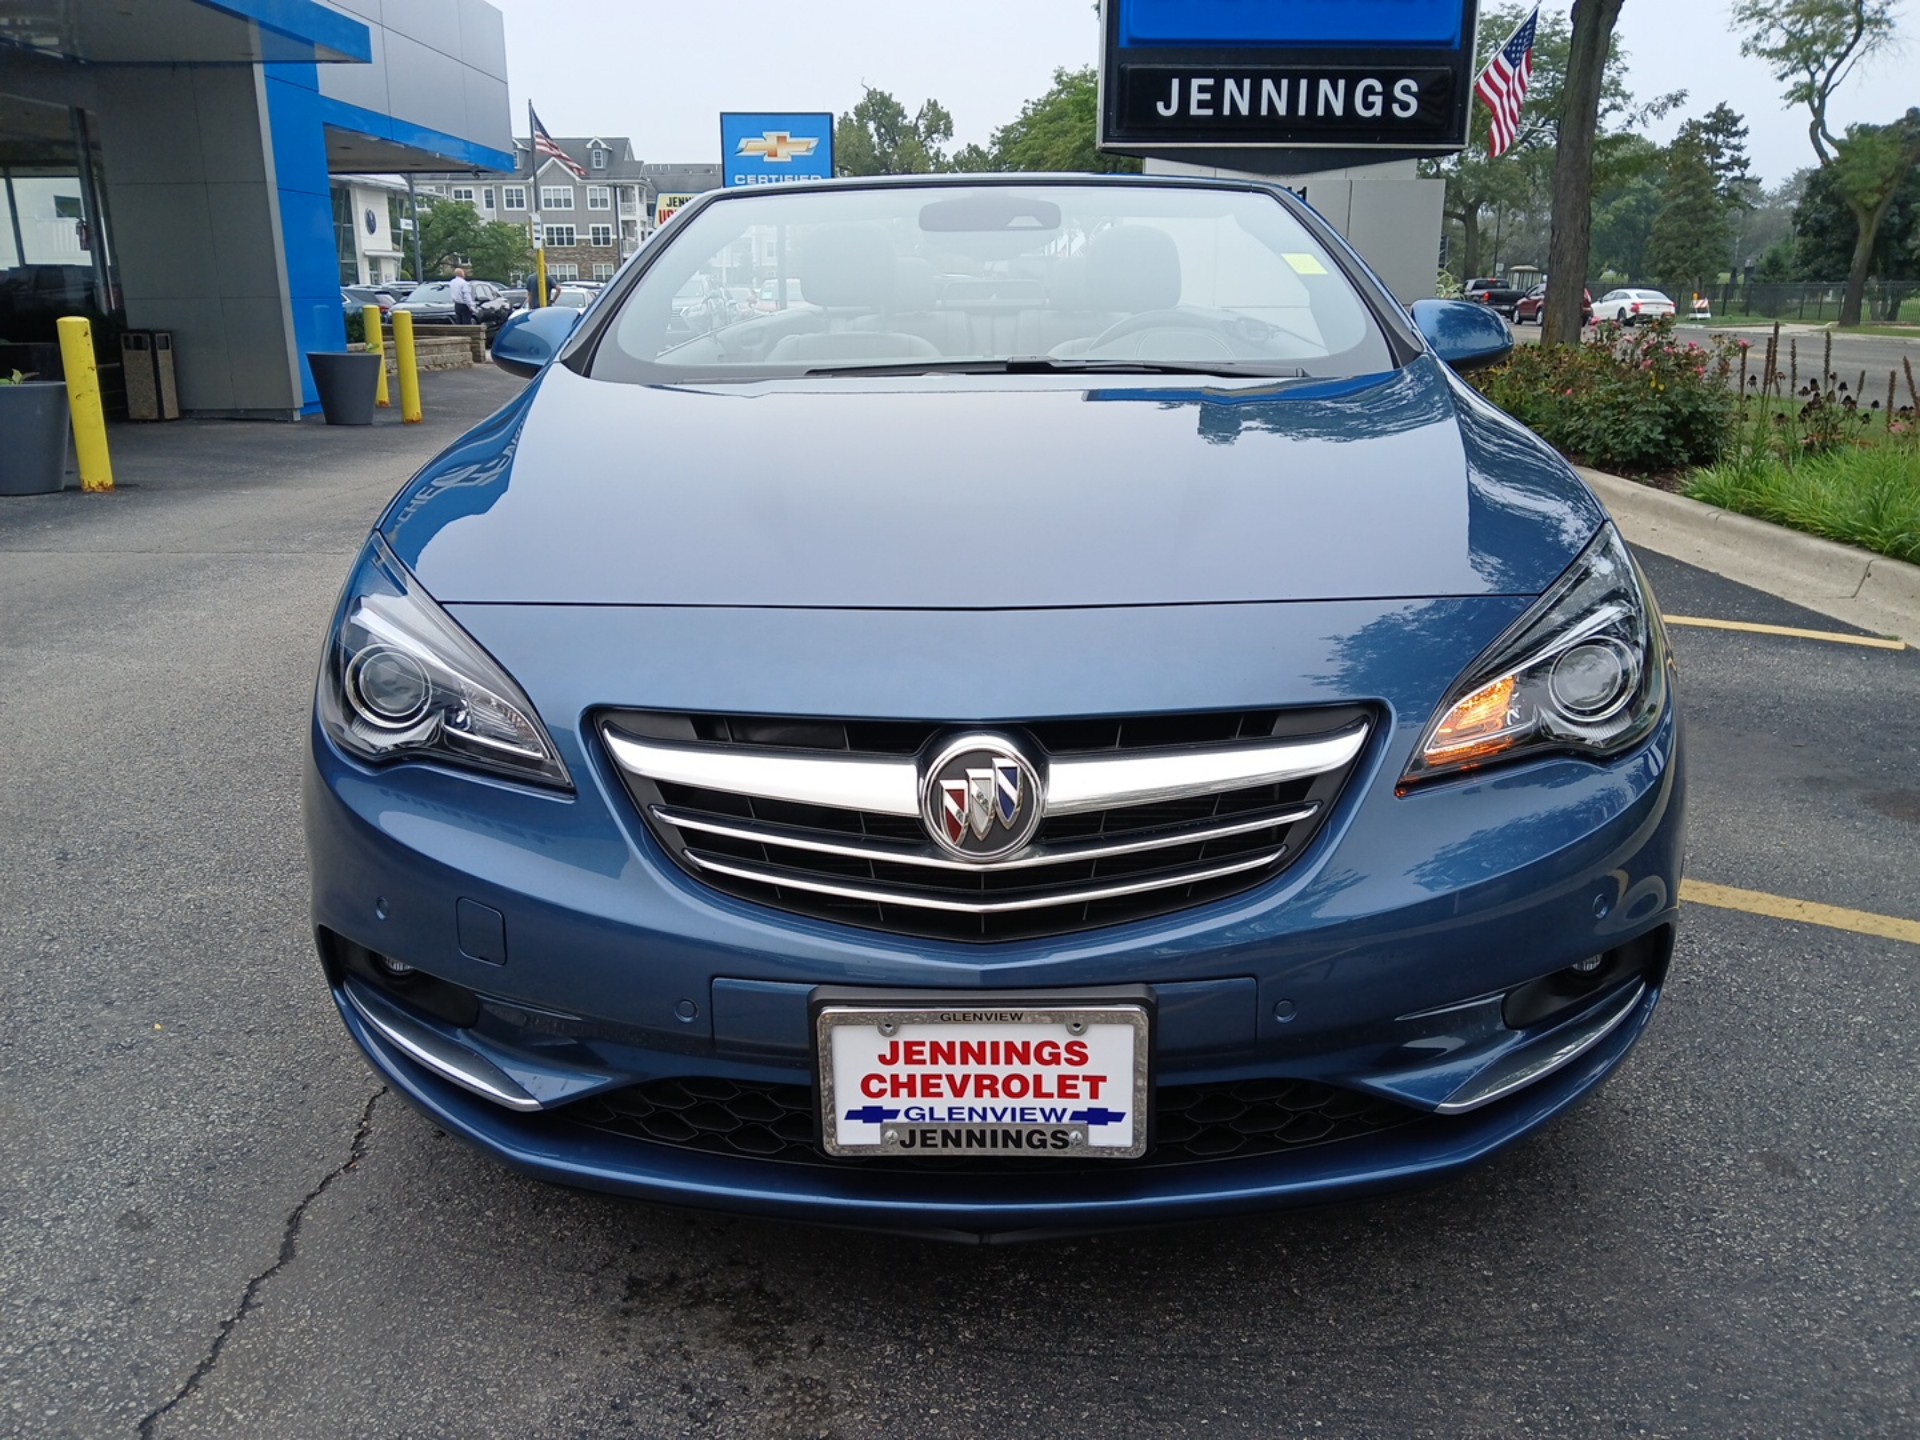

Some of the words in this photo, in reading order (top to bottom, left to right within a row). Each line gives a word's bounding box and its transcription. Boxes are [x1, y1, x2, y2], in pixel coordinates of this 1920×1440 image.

[1156, 78, 1419, 118] JENNINGS
[940, 1012, 1024, 1022] GLENVIEW
[878, 1040, 1089, 1066] JENNINGS
[860, 1073, 1107, 1099] CHEVROLET
[904, 1106, 1068, 1122] GLENVIEW
[900, 1129, 1070, 1149] JENNINGS
